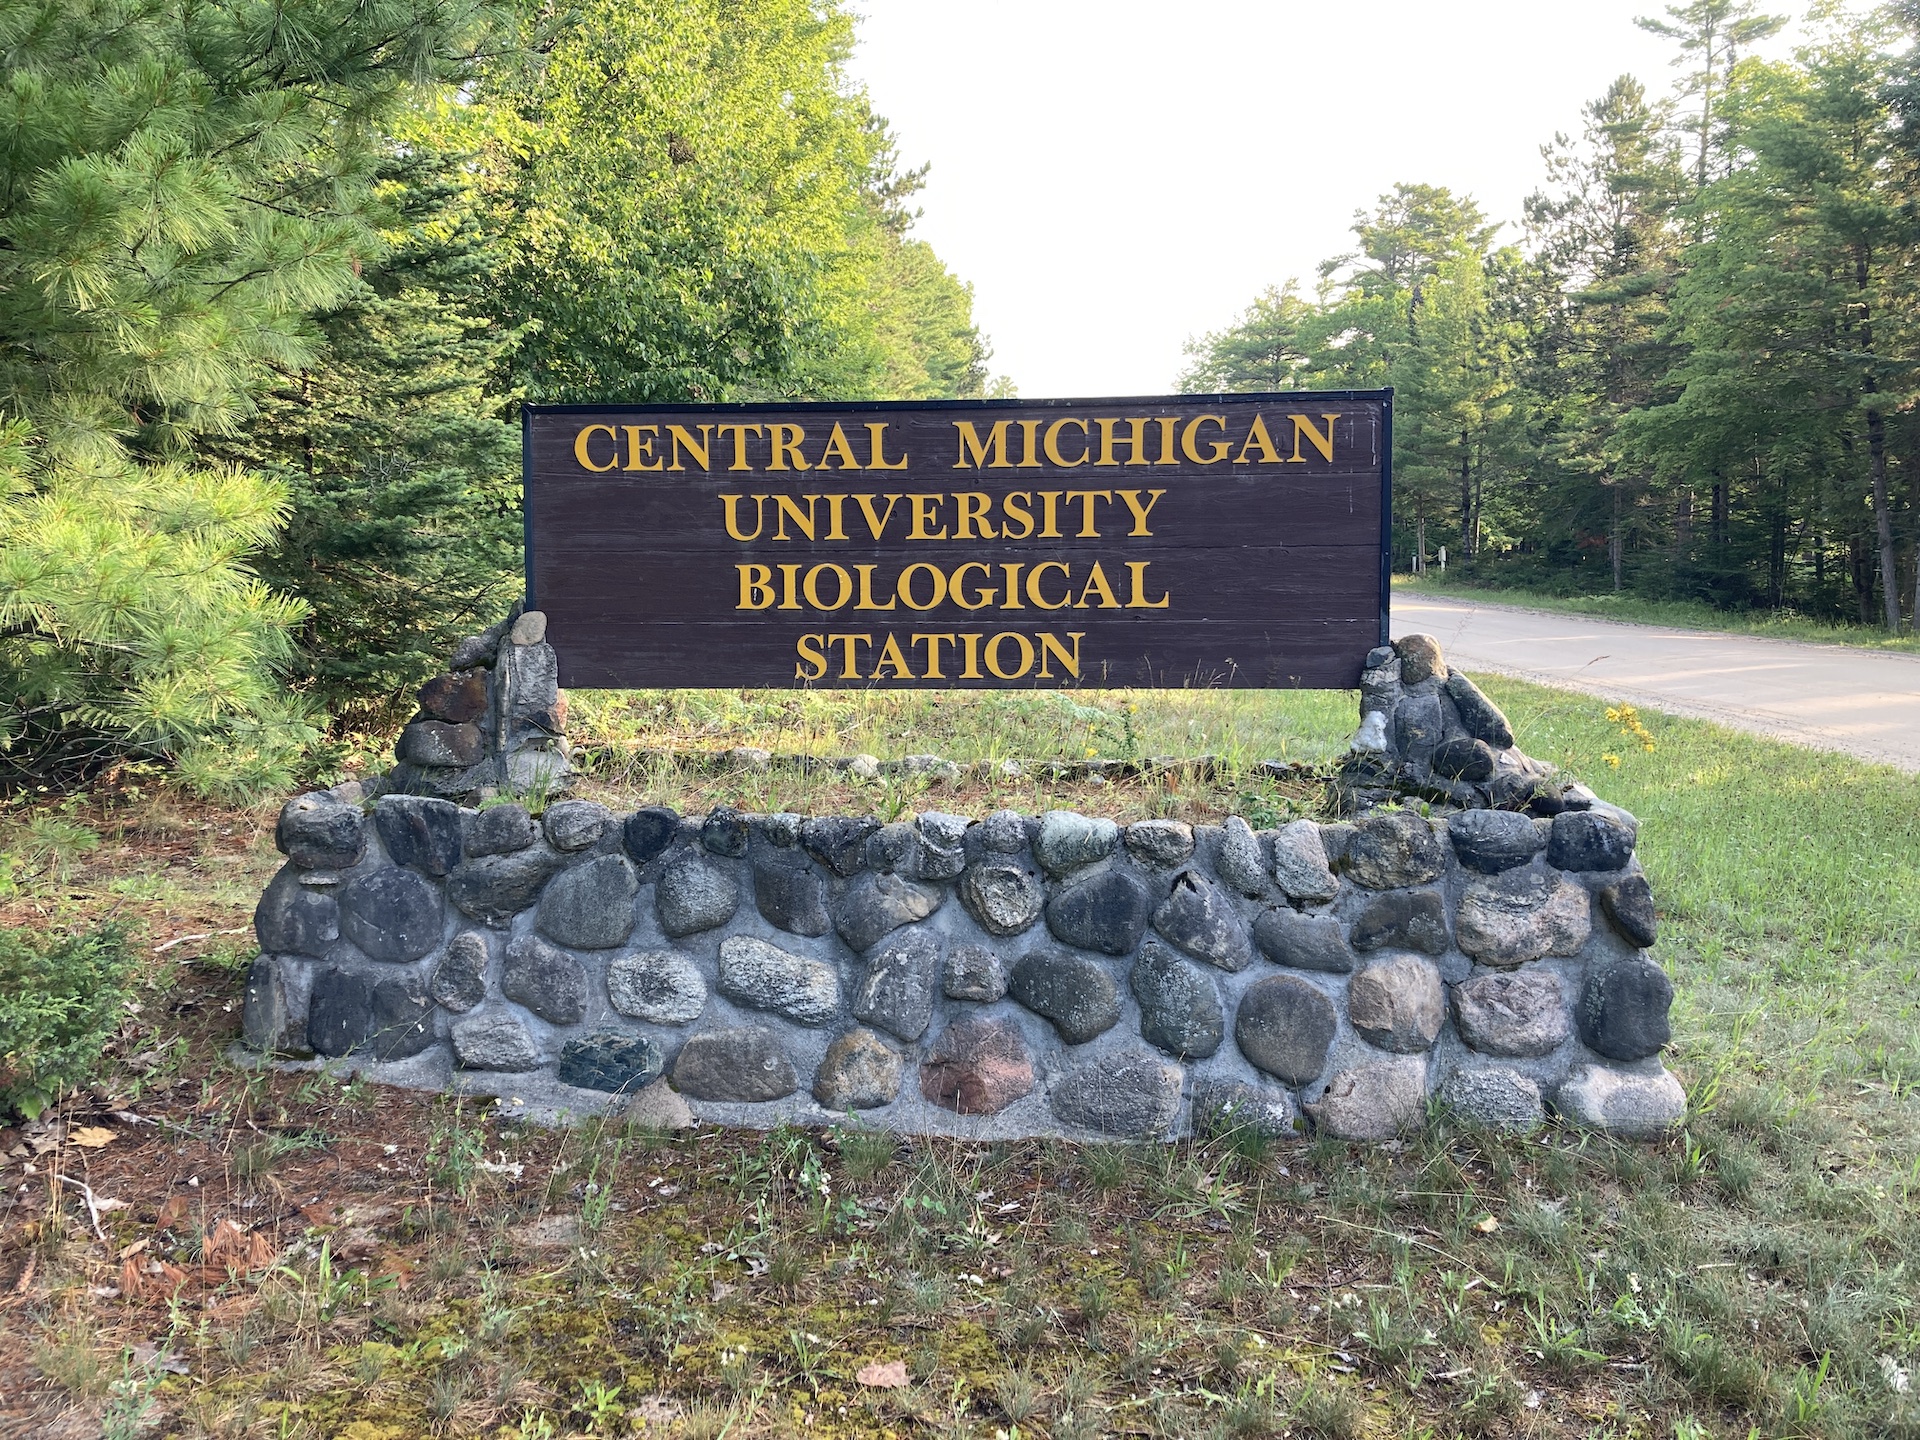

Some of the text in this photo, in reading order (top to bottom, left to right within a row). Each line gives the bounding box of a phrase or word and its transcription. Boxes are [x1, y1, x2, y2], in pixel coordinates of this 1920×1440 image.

[574, 413, 1341, 472] CENTRAL MICHIGAN
[718, 489, 1167, 541] UNIVERSITY
[735, 561, 1170, 612] BIOLOGICAL
[795, 631, 1086, 682] STATION
